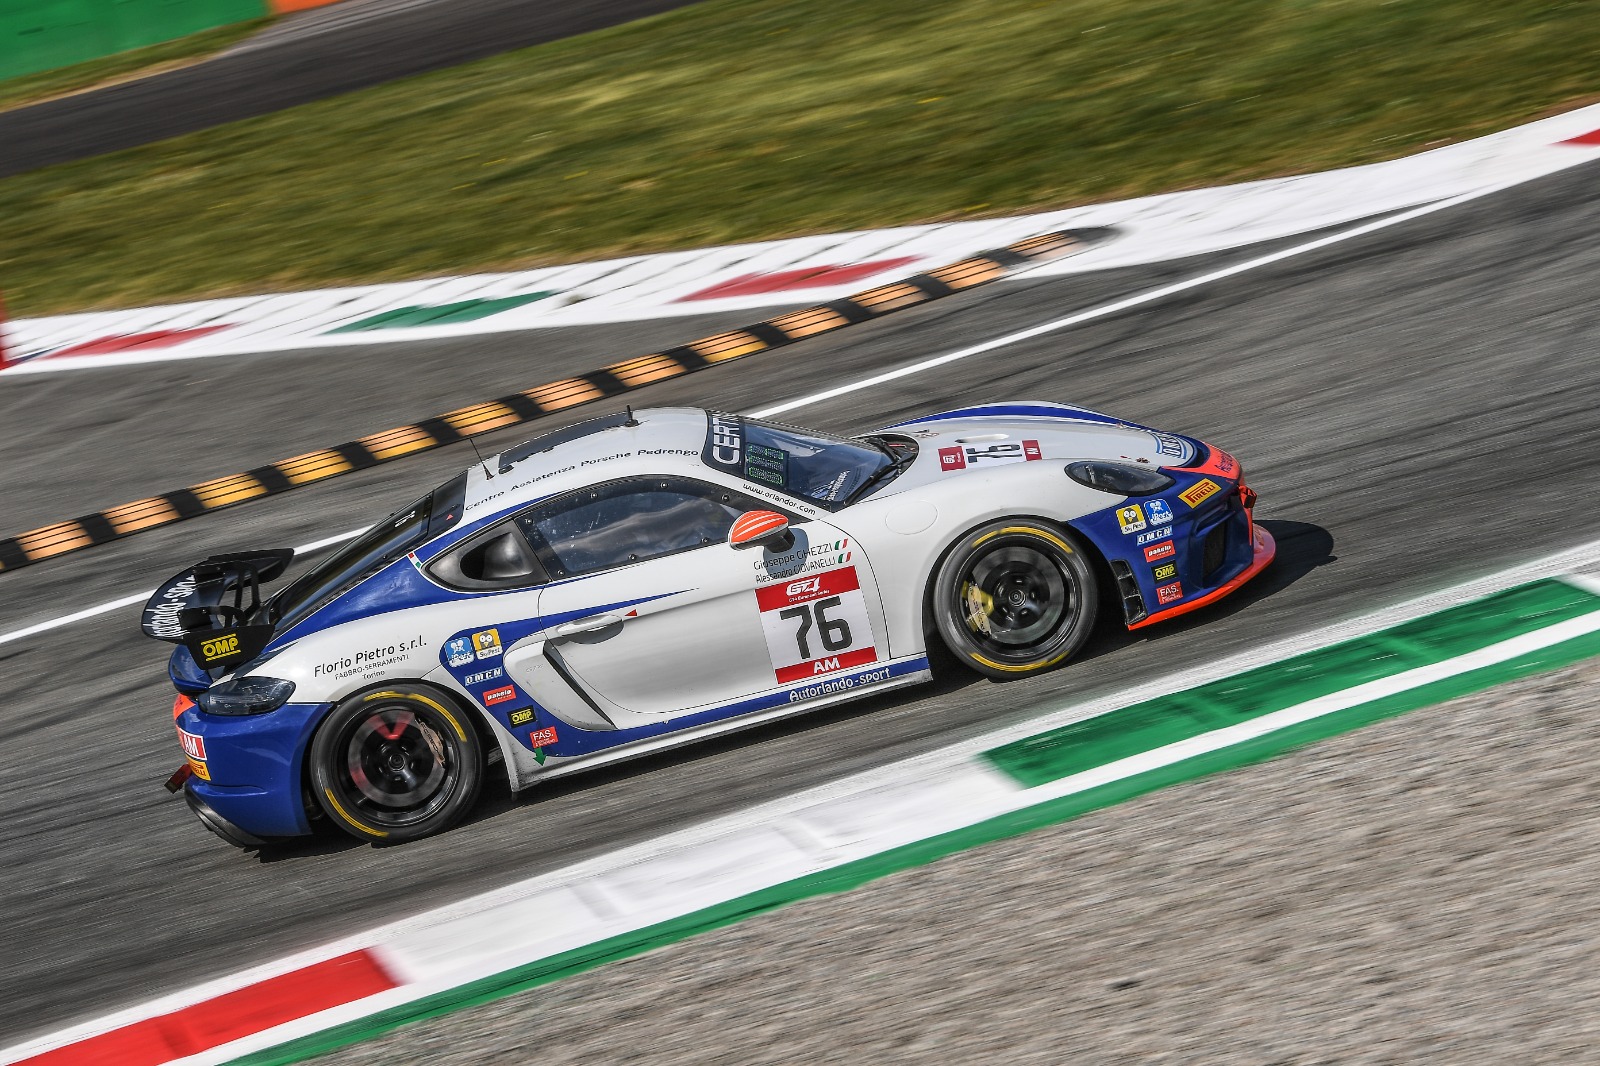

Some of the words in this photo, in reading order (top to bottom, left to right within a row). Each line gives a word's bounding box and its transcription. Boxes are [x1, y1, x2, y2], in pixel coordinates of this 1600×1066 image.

[465, 491, 505, 511] Centro
[510, 464, 576, 492] Assistenza
[580, 452, 632, 467] Porsche
[637, 448, 699, 457] Pedrengo
[743, 483, 816, 516] www.orlandor.com
[1184, 481, 1216, 504] PIRELLI
[753, 554, 795, 570] Giuseppe
[796, 543, 833, 560] GHEZZI
[755, 568, 793, 584] Alessandro
[793, 556, 836, 575] GIOVANELLI
[1155, 565, 1175, 578] OMP
[786, 576, 821, 596] GT4
[779, 595, 852, 659] 76
[202, 637, 239, 657] OMP
[314, 657, 352, 677] Florio
[355, 645, 395, 664] Pietro
[399, 635, 427, 653] s.r.l.
[334, 654, 410, 680] FABBRO-SERRAMENTI
[362, 670, 385, 680] Torino
[813, 657, 841, 673] AM
[789, 667, 891, 702] Autorlando-sport
[511, 709, 533, 723] OMP
[183, 734, 199, 757] AM
[532, 730, 554, 741] FAS.
